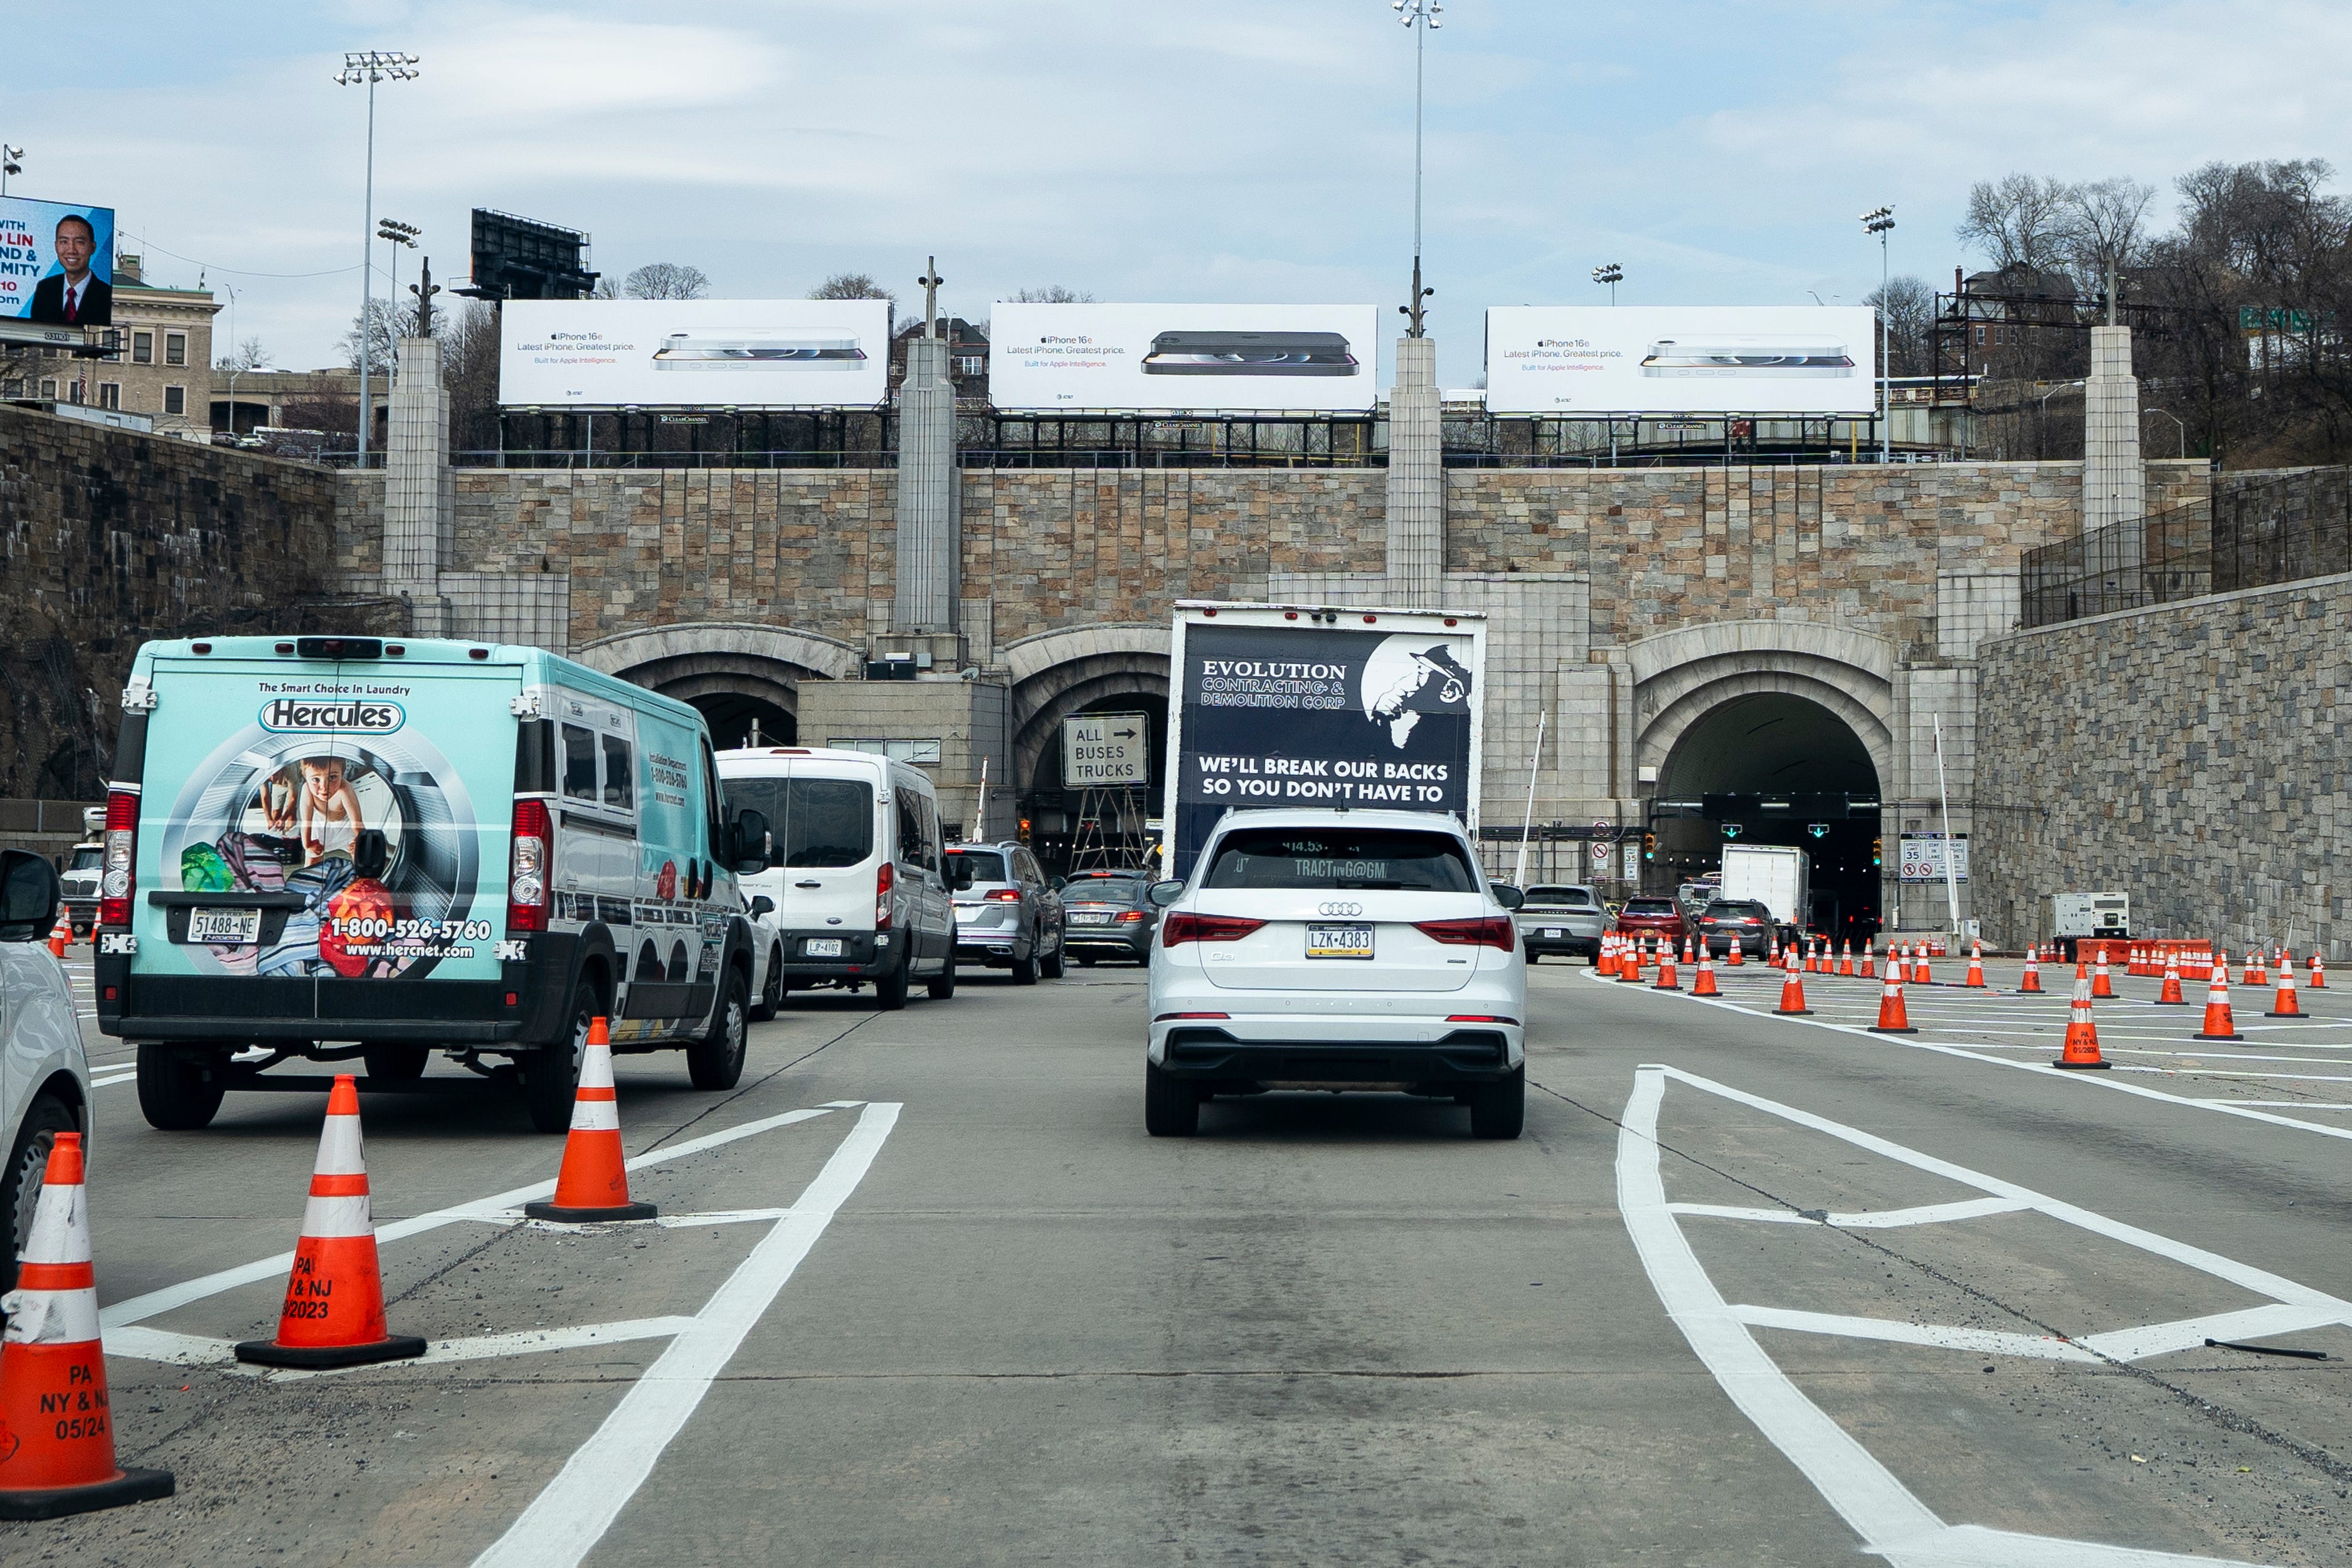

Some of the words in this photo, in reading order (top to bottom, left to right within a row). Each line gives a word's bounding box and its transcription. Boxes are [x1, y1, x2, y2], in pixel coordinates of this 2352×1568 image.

[8, 232, 33, 246] LIN
[26, 250, 36, 262] &
[0, 262, 40, 277] MITY
[558, 332, 587, 341] iPhone
[589, 332, 603, 341] 16e
[1047, 336, 1076, 344] iPhone
[1079, 336, 1093, 344] 16e
[1544, 339, 1574, 347] iPhone
[1576, 339, 1590, 347] 16e
[613, 343, 636, 352] price.
[1007, 346, 1032, 354] Latest
[1034, 346, 1064, 354] iPhone.
[1066, 346, 1101, 354] Greatest
[1103, 346, 1125, 355] price.
[1532, 349, 1562, 358] iPhone.
[1563, 349, 1598, 358] Greatest
[1600, 350, 1623, 359] price.
[580, 357, 617, 365] Intelligence.
[1202, 660, 1347, 680] EVOLUTION
[259, 682, 278, 692] The
[281, 683, 310, 692] Smart
[314, 683, 349, 694] Choice
[352, 684, 362, 694] In
[366, 684, 410, 696] Laundry
[1201, 677, 1329, 696] CONTRACTING
[1330, 681, 1345, 696] &
[1200, 692, 1299, 709] DEMOLITION
[1301, 695, 1346, 711] CORP
[272, 699, 391, 727] Hercules
[1076, 729, 1103, 741] ALL
[1076, 746, 1124, 760] BUSES
[1076, 763, 1133, 778] TRUCKS
[1199, 756, 1258, 774] WE'LL
[1264, 758, 1328, 776] BREAK
[1334, 761, 1379, 778] OUR
[1384, 763, 1448, 781] BACKS
[1202, 778, 1231, 794] SO
[1237, 779, 1280, 797] YOU
[1286, 780, 1353, 799] DON'T
[1359, 783, 1411, 801] HAVE
[1416, 786, 1443, 803] TO
[1906, 851, 1919, 859] 35
[196, 916, 232, 933] 51488
[240, 917, 255, 933] NE
[331, 918, 492, 941] 1-800-526-5760
[1311, 932, 1333, 948] LZK
[1339, 931, 1369, 948] 4383
[346, 944, 474, 958] www.hercnet.com
[295, 1257, 310, 1274] PA
[295, 1279, 304, 1296] &
[309, 1279, 332, 1296] NJ
[70, 1364, 92, 1385] PA
[40, 1392, 72, 1414] NY
[77, 1391, 91, 1411] &
[55, 1415, 105, 1440] 05/24
